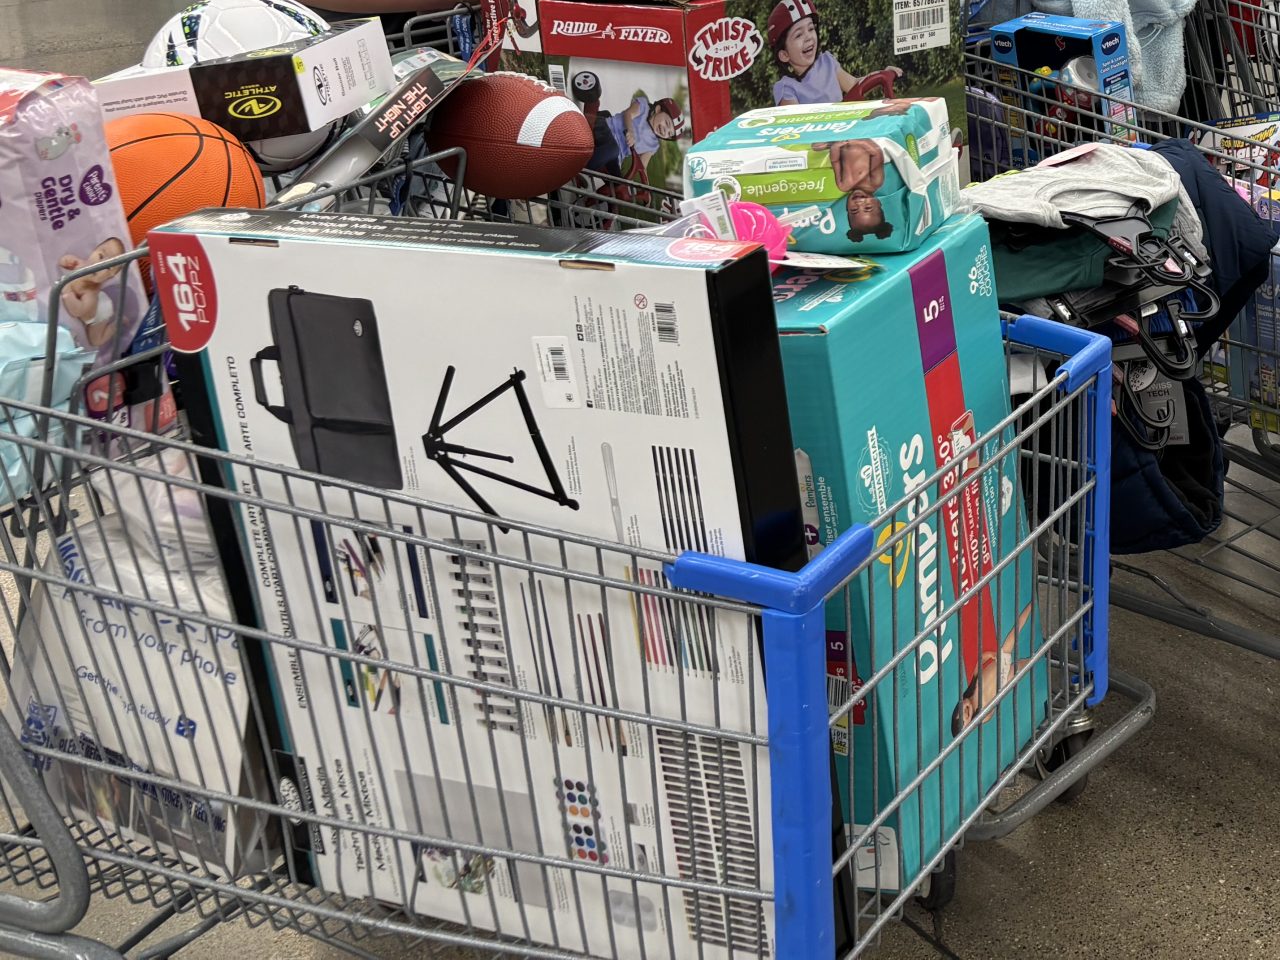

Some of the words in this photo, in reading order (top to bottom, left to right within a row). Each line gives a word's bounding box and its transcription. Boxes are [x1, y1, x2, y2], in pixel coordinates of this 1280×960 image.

[895, 1, 912, 11] ITEM:
[550, 19, 597, 37] RADIO
[619, 26, 673, 45] FLYER
[698, 19, 752, 46] TWIST
[994, 39, 1013, 48] vtech
[1101, 36, 1120, 49] vtech
[702, 46, 753, 78] TRIKE
[224, 85, 278, 100] ATHLETIC
[402, 80, 427, 105] THE
[372, 99, 408, 134] NIGHT
[401, 93, 433, 125] LIGHT
[386, 120, 406, 140] UP
[41, 176, 65, 231] Gentle
[58, 173, 77, 207] Dry
[34, 191, 48, 221] Diapers
[66, 207, 81, 221] &
[299, 212, 339, 222] Mixed
[340, 215, 378, 224] Media
[288, 219, 350, 229] Technique
[351, 223, 387, 231] Mixte
[968, 265, 978, 296] 96
[974, 253, 986, 296] DIAPERS
[982, 244, 993, 297] COUCHES
[165, 252, 198, 332] 164
[187, 255, 210, 324] PC/PZ
[923, 299, 940, 323] 5
[226, 355, 247, 419] COMPLETO
[238, 421, 253, 451] ARTE
[1147, 389, 1171, 398] TECH
[868, 427, 887, 515] PEDIATRICIAN
[816, 475, 826, 517] ensemble
[253, 531, 271, 588] COMPLETE
[79, 609, 128, 639] from
[136, 632, 178, 657] your
[180, 648, 237, 686] phone
[75, 664, 98, 684] Get
[287, 648, 308, 710] ENSEMBLE
